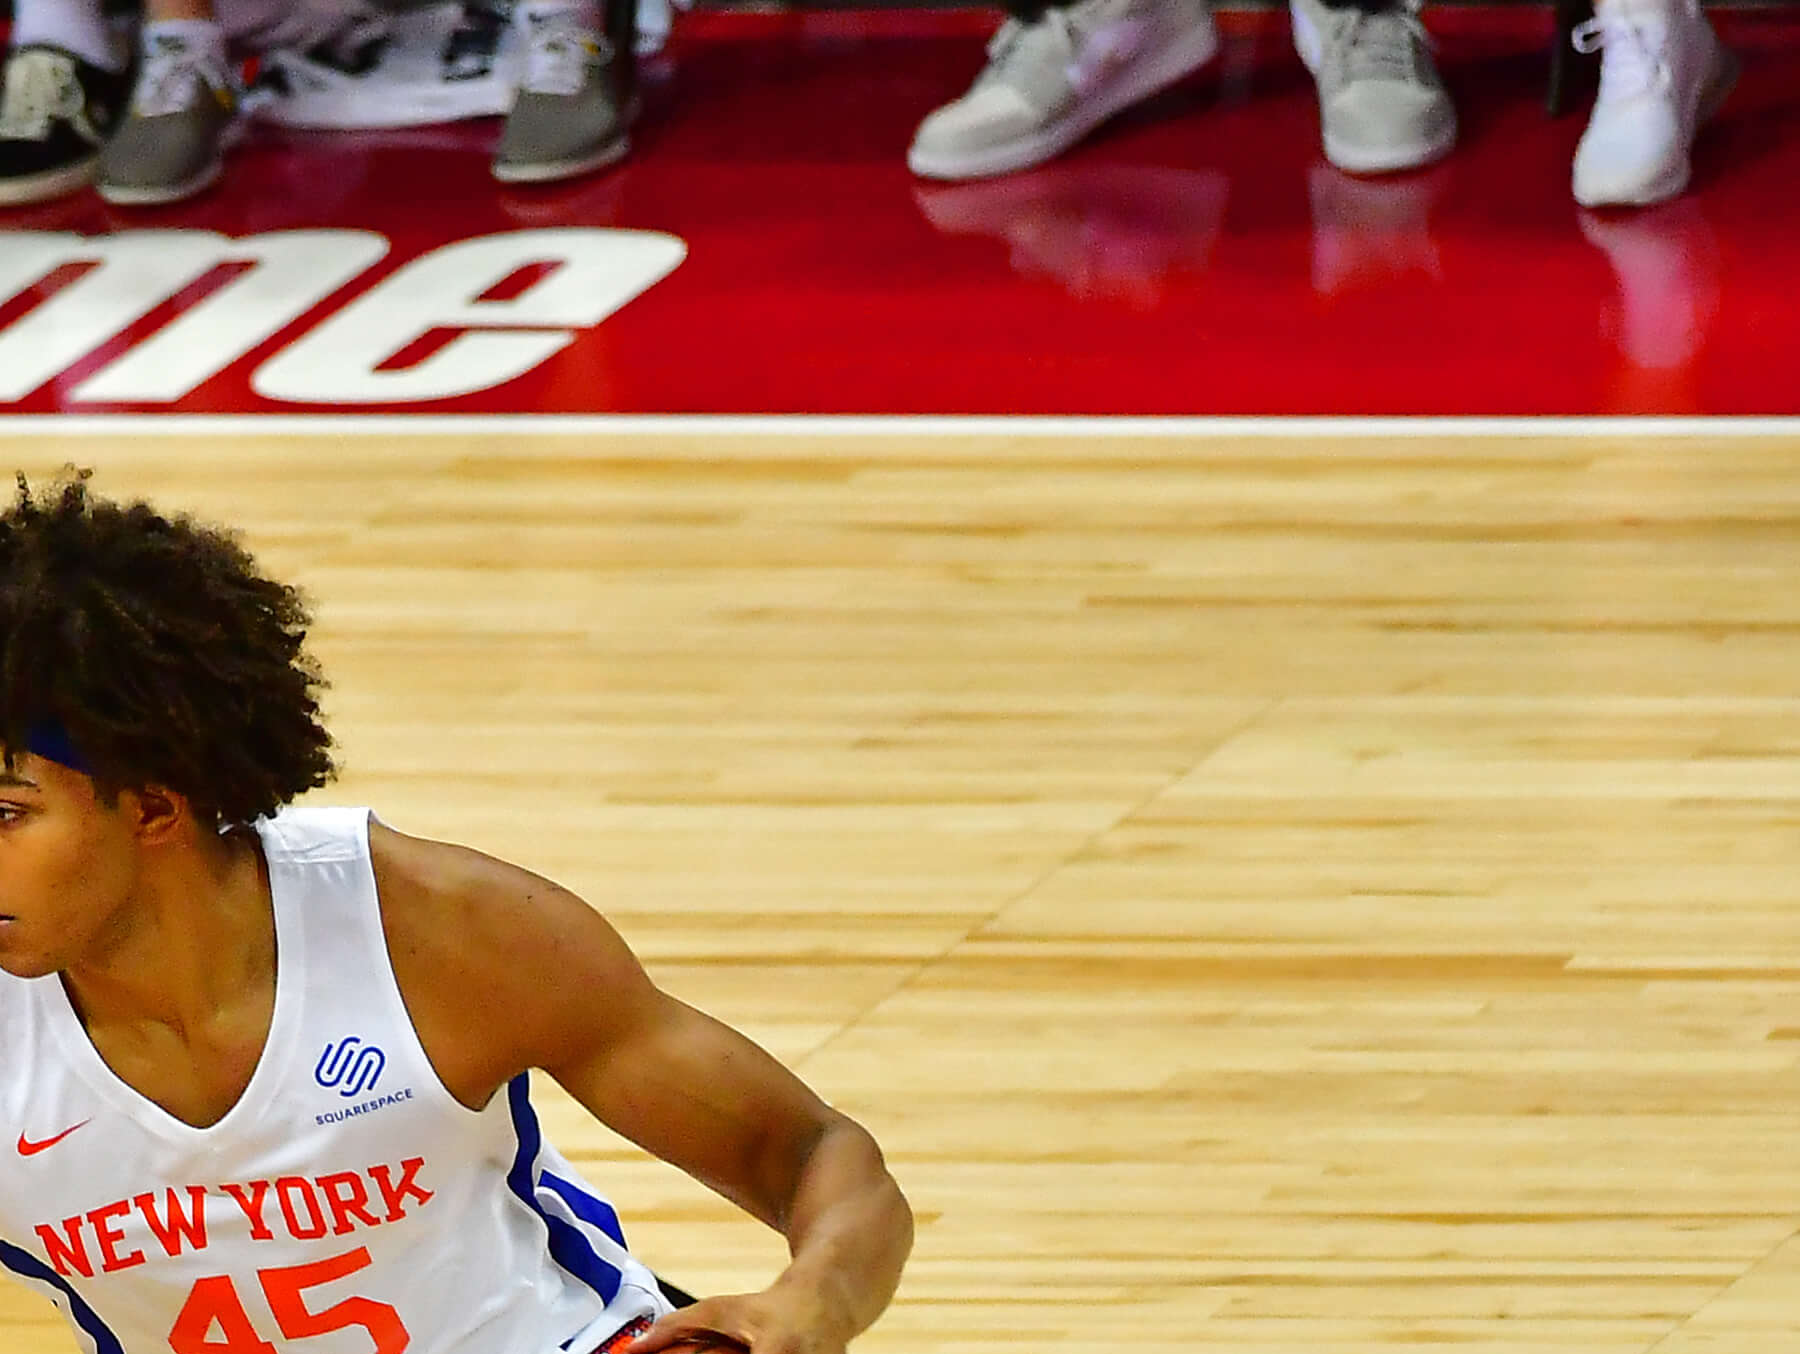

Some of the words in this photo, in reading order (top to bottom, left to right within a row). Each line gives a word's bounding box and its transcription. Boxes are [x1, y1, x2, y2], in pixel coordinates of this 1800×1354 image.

[315, 1088, 414, 1125] SQUARESPACE
[35, 1185, 208, 1279] NEW
[219, 1156, 436, 1241] YORK
